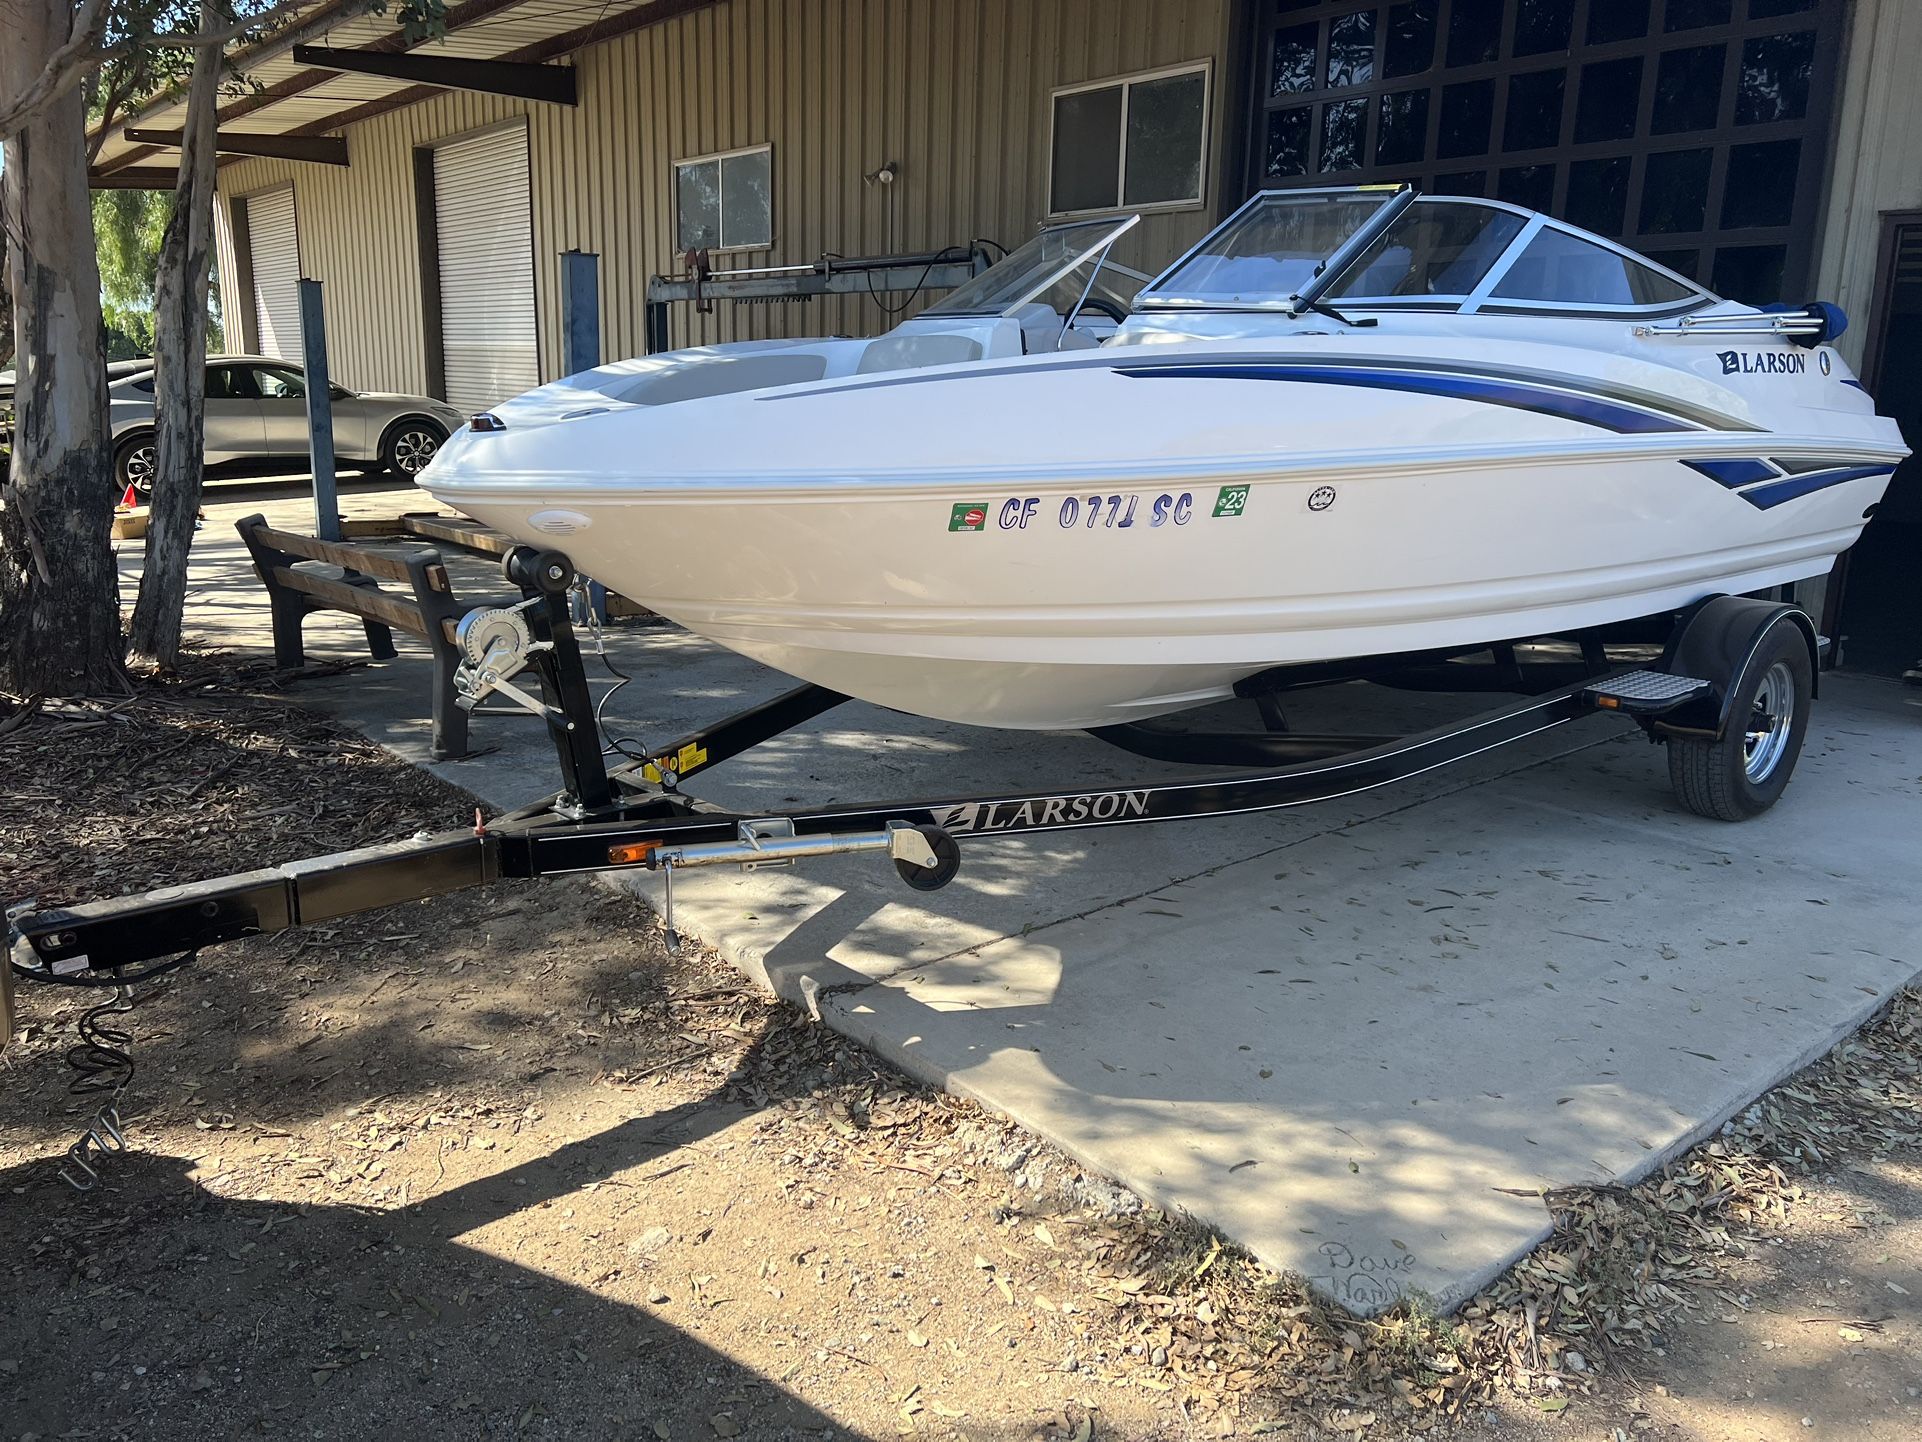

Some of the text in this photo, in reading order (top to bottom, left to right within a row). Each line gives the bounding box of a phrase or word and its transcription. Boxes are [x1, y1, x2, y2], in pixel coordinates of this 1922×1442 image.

[1742, 351, 1805, 374] LARSON
[999, 497, 1041, 530] CF
[1150, 492, 1193, 528] SC
[1224, 491, 1247, 509] 23
[980, 789, 1153, 830] LARSON
